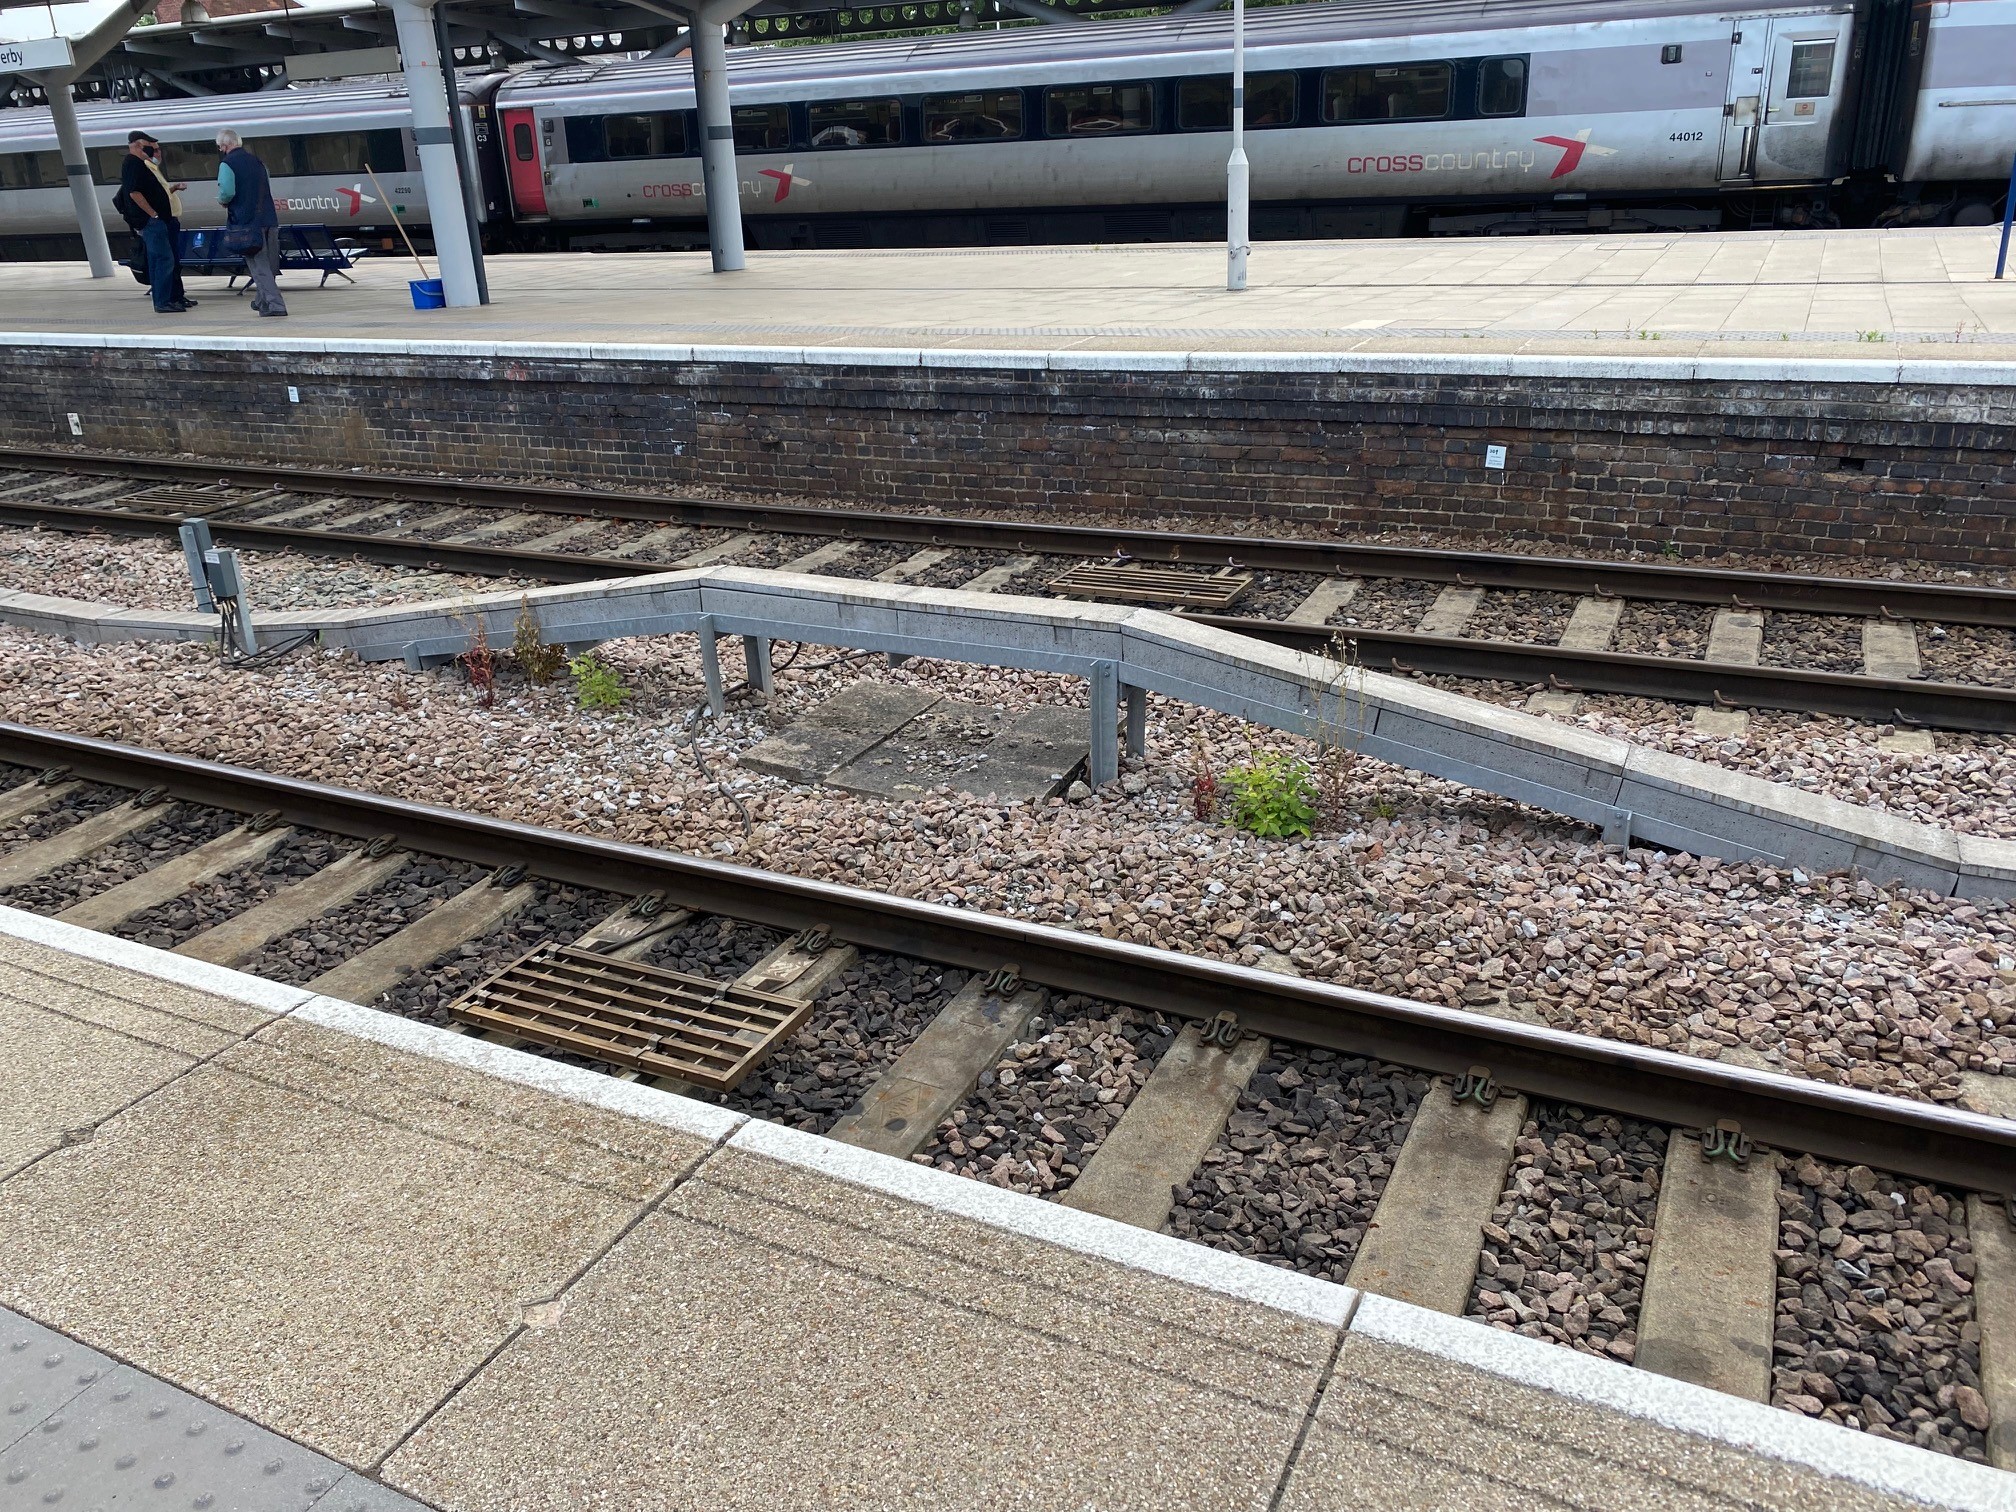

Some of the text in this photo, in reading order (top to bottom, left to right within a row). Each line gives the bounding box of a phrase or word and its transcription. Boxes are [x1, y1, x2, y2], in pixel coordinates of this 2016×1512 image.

[1669, 131, 1703, 142] 44012
[1347, 148, 1535, 174] crosscountry
[643, 180, 762, 198] crosscry
[273, 195, 340, 212] sscountry
